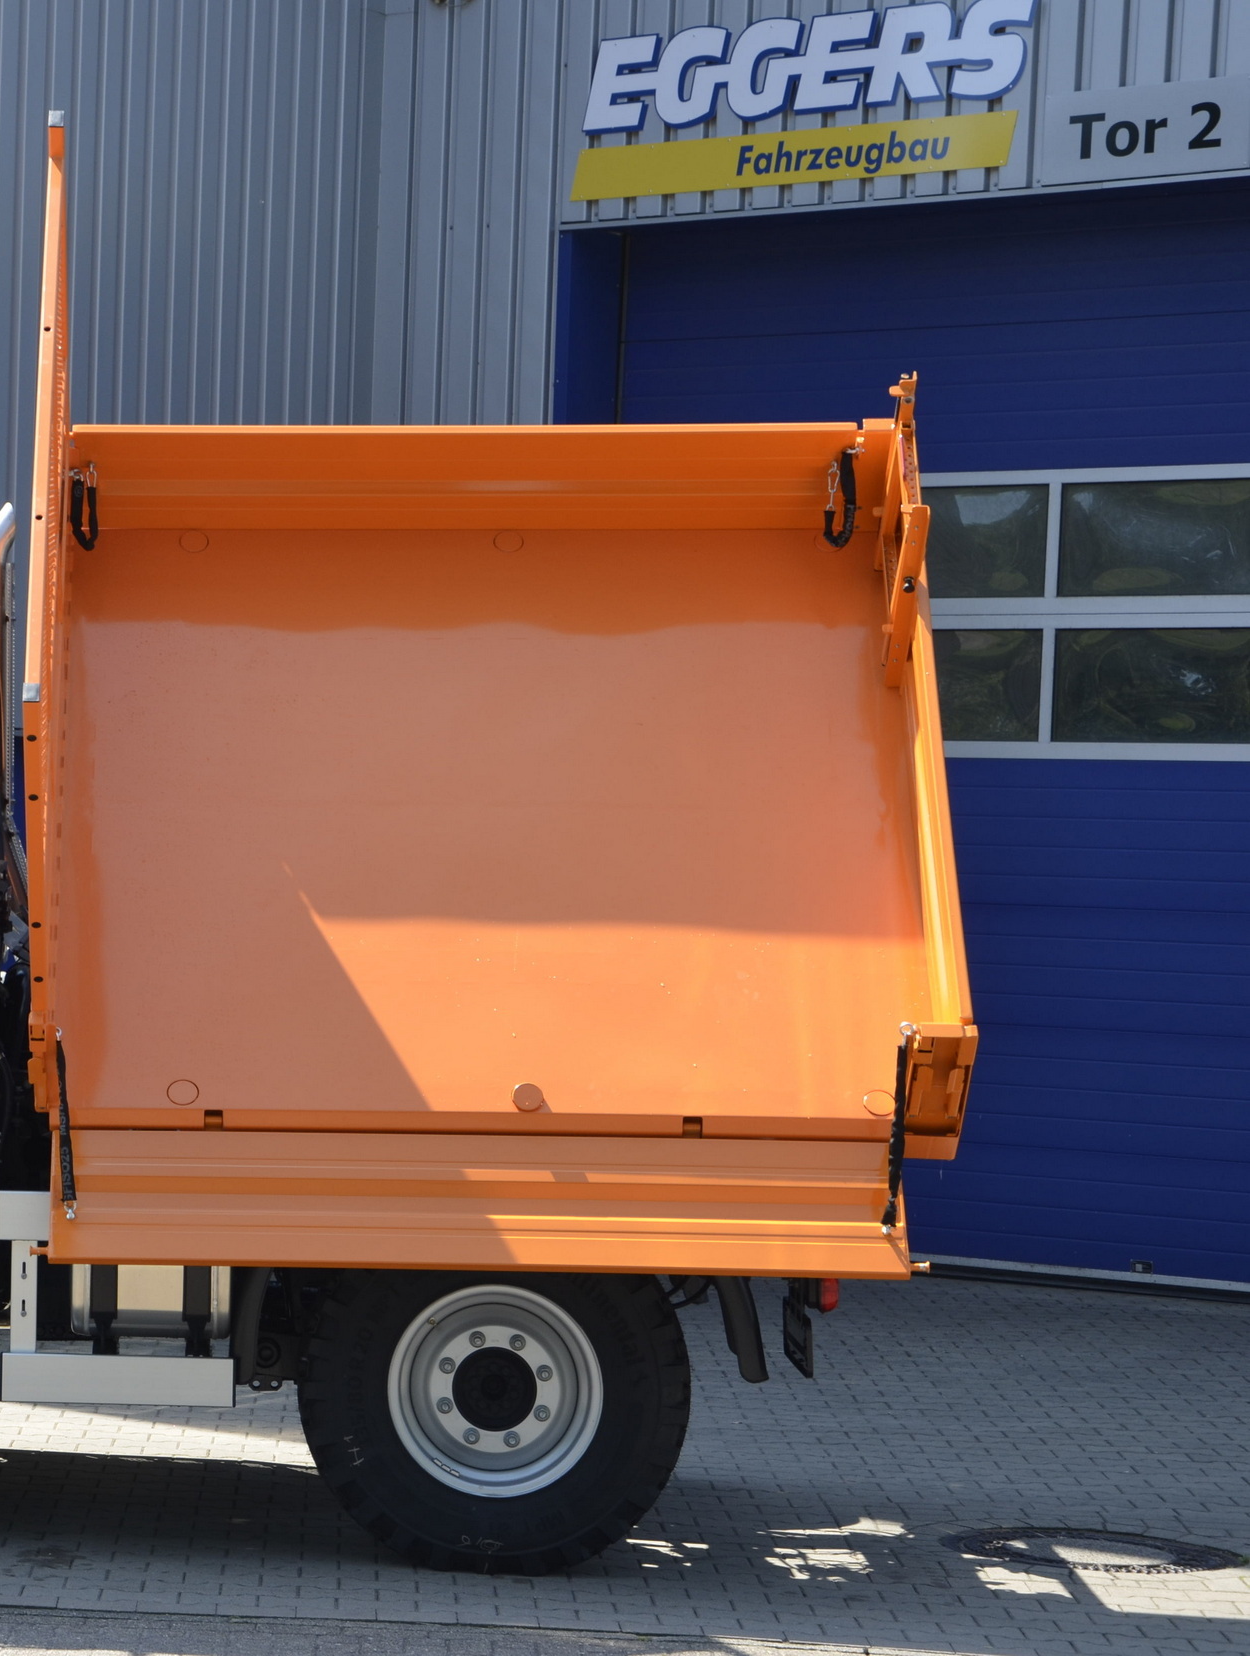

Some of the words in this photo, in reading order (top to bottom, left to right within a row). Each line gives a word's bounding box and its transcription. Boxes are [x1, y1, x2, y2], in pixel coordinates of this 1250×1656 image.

[582, 0, 1039, 135] EGGERS
[736, 130, 950, 176] Fahrzeugbau
[1069, 112, 1168, 160] Tor
[1188, 101, 1222, 149] 2
